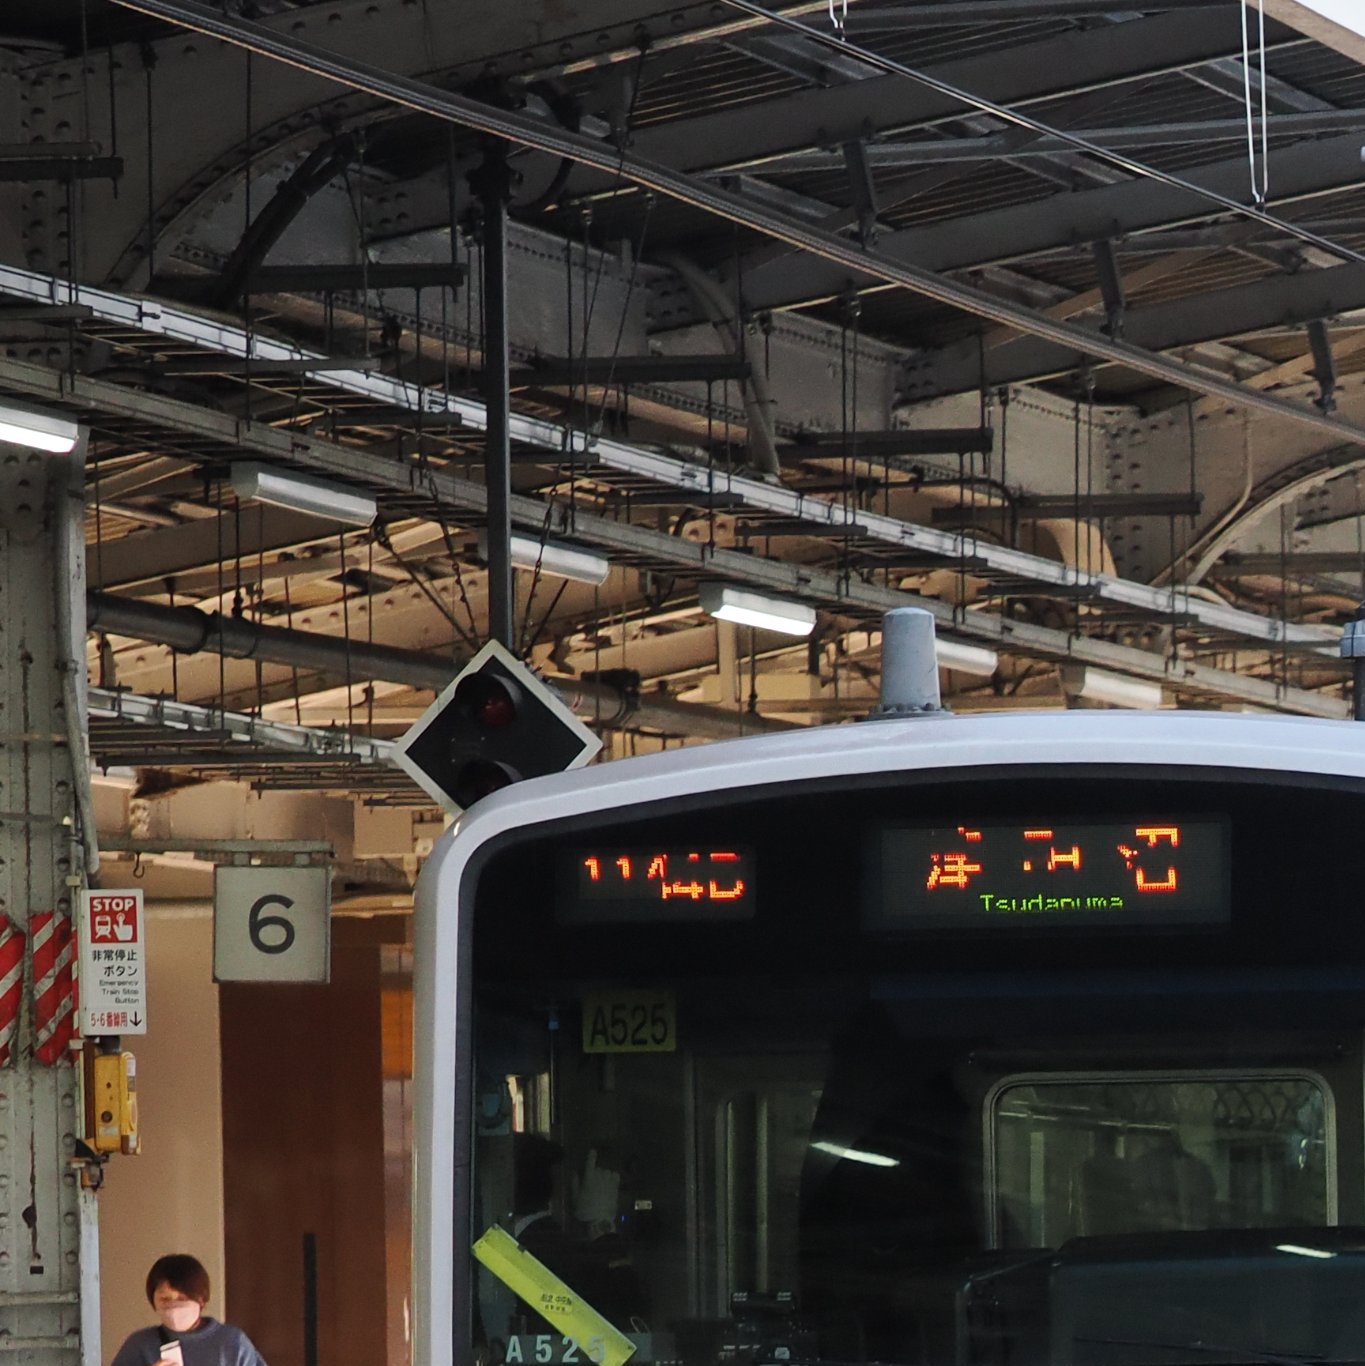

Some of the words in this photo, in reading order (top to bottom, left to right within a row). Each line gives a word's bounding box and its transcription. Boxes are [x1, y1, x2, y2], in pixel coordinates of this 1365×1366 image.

[93, 899, 134, 911] STOP
[249, 894, 296, 955] 6
[92, 949, 137, 961] 非常停止
[103, 965, 137, 977] ボタン
[590, 1003, 668, 1047] A525
